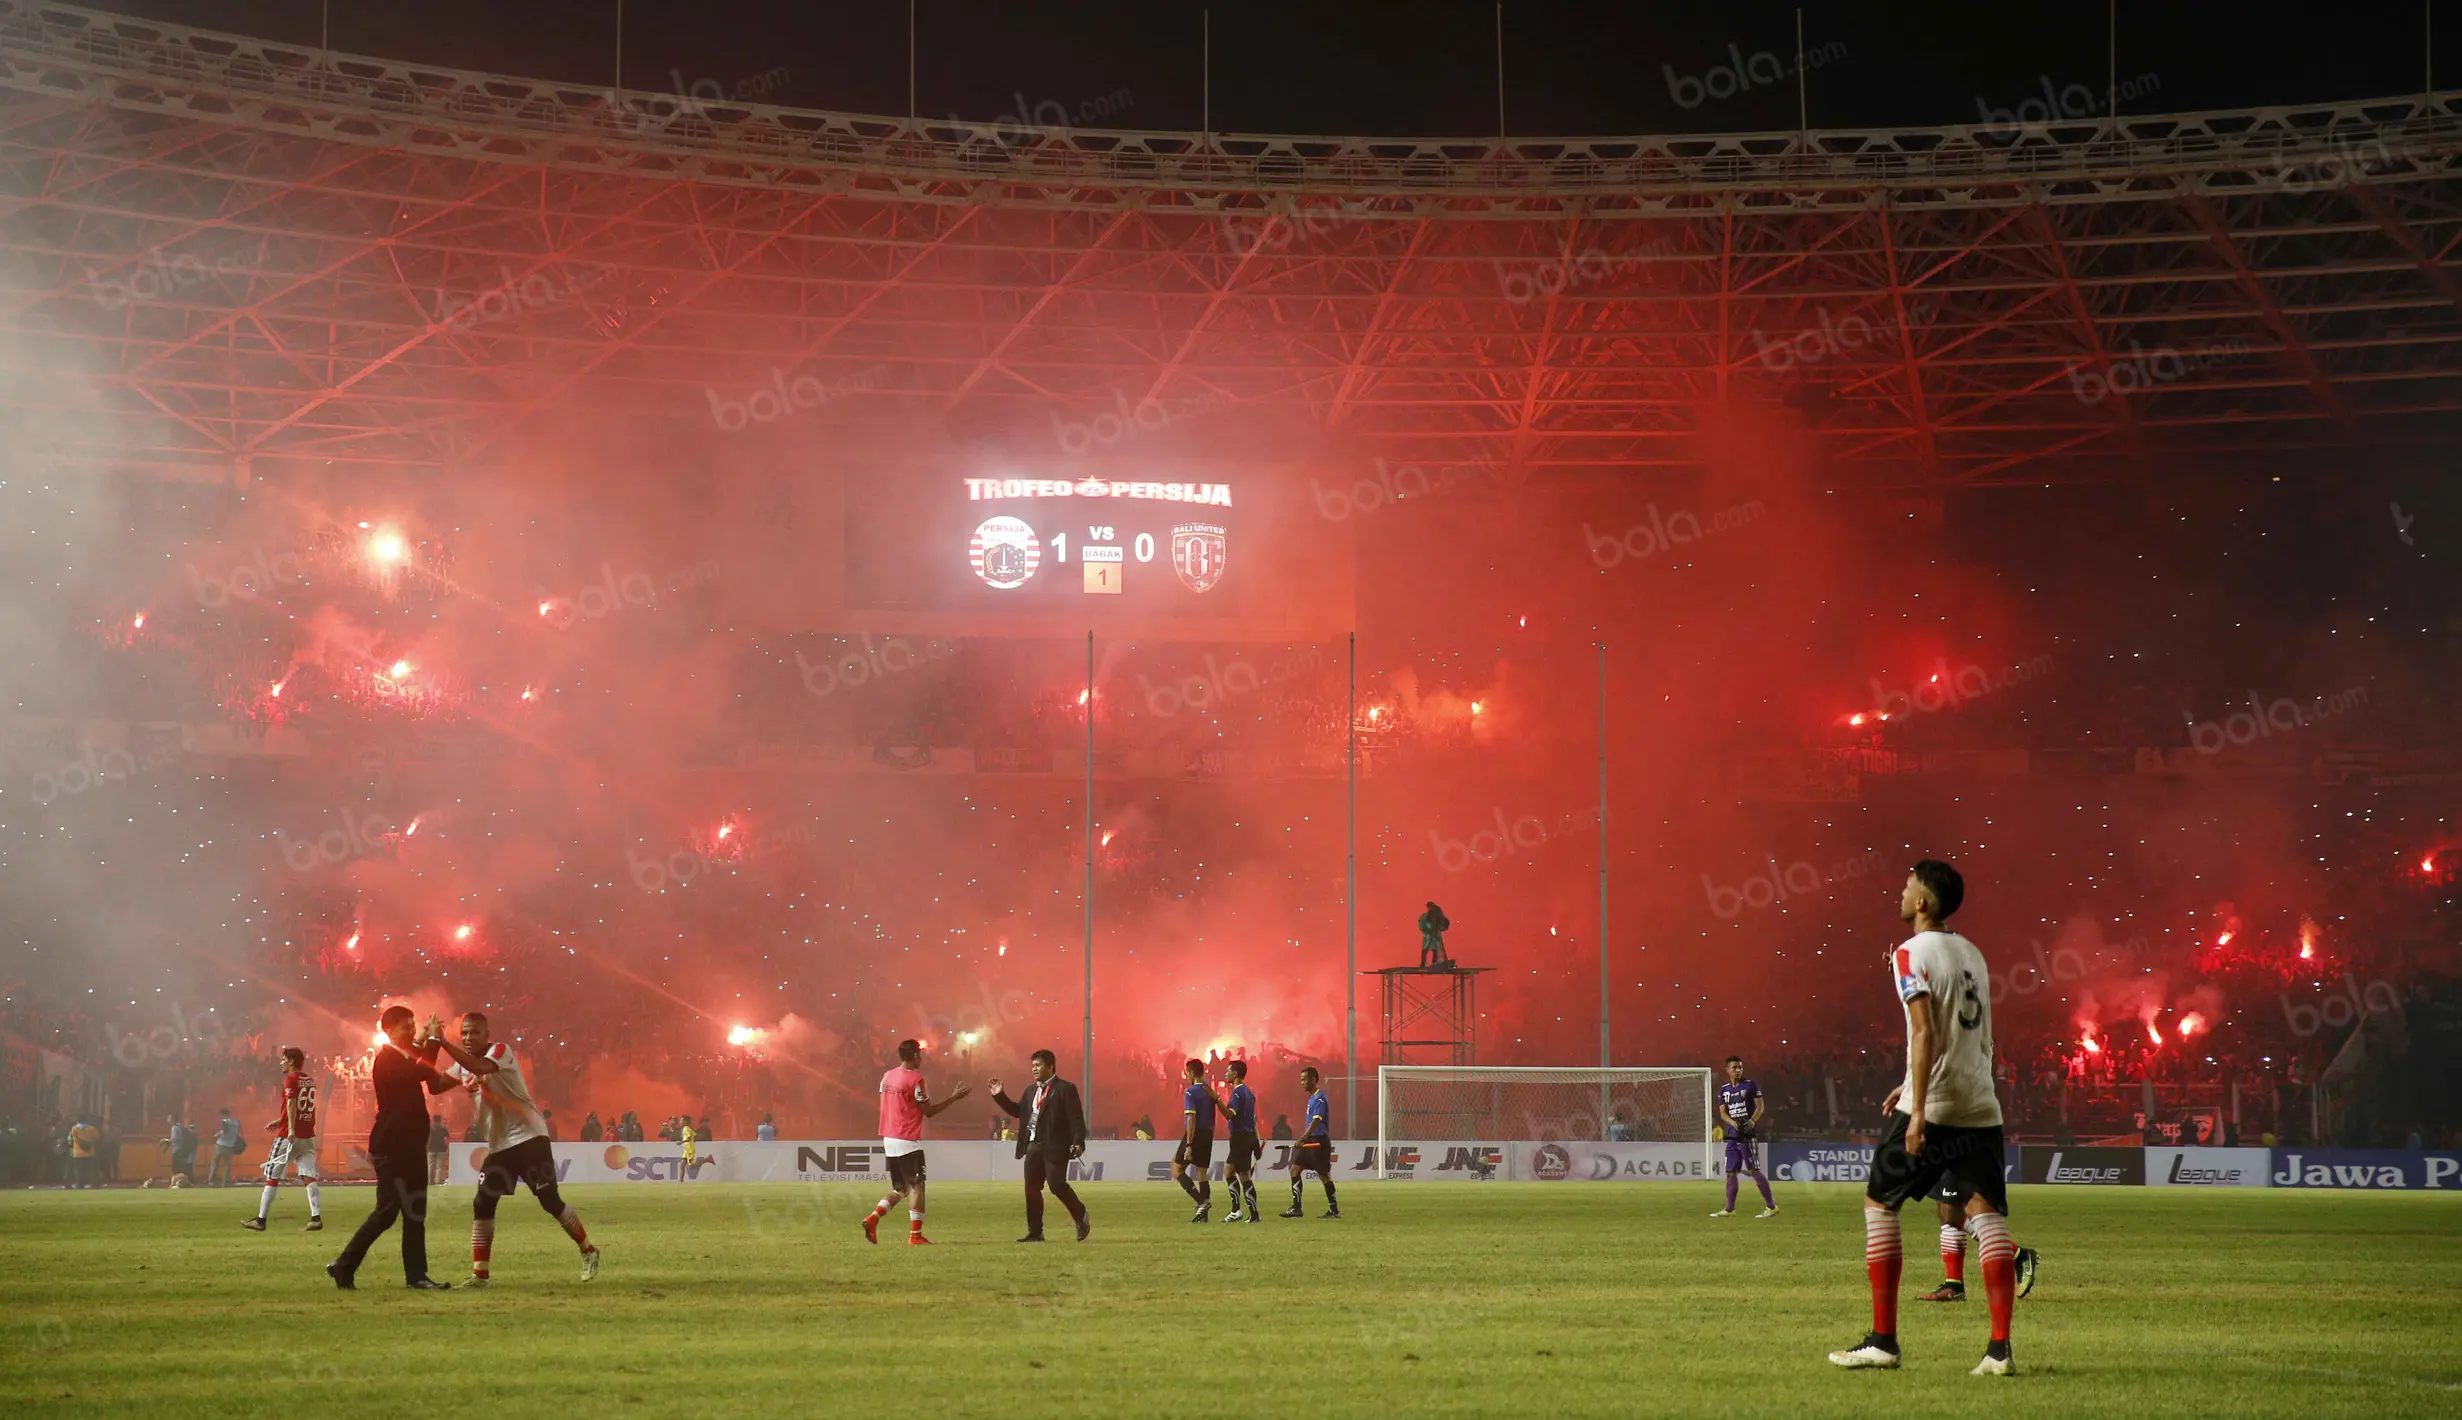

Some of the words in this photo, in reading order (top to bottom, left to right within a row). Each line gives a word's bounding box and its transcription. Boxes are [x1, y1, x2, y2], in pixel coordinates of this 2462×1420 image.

[964, 477, 1073, 501] TROFEO
[1111, 480, 1232, 507] PERSIJA
[983, 524, 1025, 533] PERSIJA
[1088, 525, 1115, 541] VS
[1173, 525, 1193, 533] BALI
[1194, 525, 1225, 534] UNITED
[1051, 532, 1066, 562] 1
[1135, 532, 1155, 562] 0
[1098, 568, 1107, 586] 1
[1957, 968, 1983, 1030] 3
[297, 1086, 317, 1112] 69
[626, 1156, 704, 1181] SCTV
[1349, 1146, 1421, 1171] JNE
[1431, 1146, 1503, 1171] JNE
[1624, 1160, 1721, 1176] ACADEM
[1808, 1150, 1859, 1162] STAND
[2045, 1152, 2122, 1184] League
[798, 1174, 850, 1182] TELEVISI
[1388, 1172, 1414, 1180] EXPRESS
[2167, 1153, 2241, 1185] League
[2273, 1154, 2408, 1188] Jawa
[2423, 1157, 2462, 1188] P
